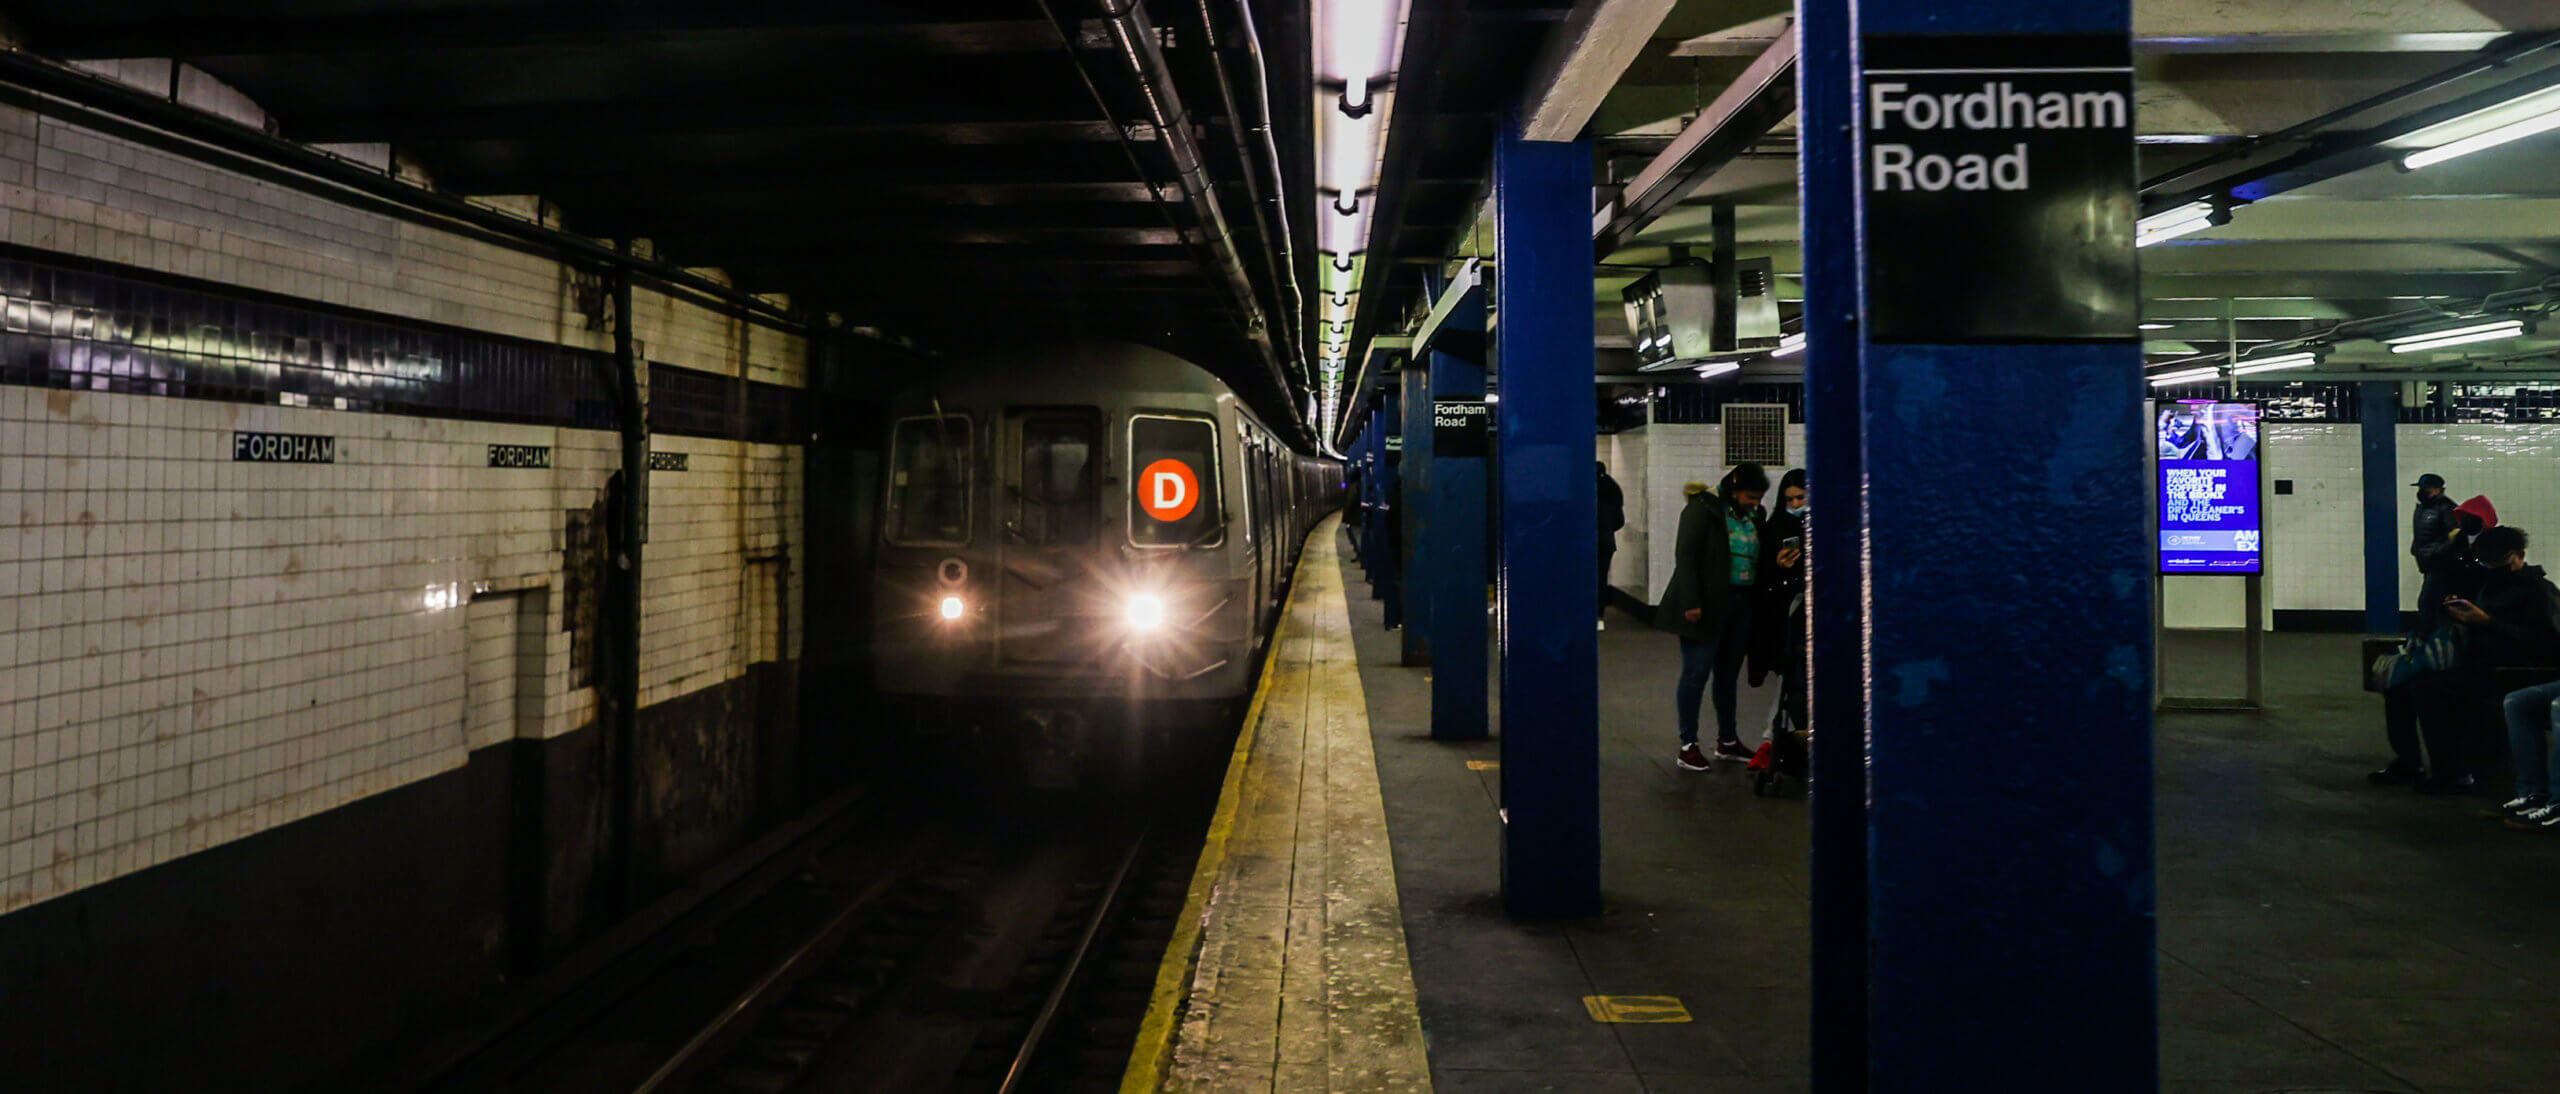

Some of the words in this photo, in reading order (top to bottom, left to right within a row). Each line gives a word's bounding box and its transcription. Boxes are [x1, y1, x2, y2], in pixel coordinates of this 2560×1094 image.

[1870, 82, 2127, 130] Fordham
[1872, 143, 2029, 191] Road
[1435, 404, 1486, 415] Fordham
[1435, 417, 1466, 427] Road
[235, 433, 333, 461] FORDHAM
[488, 446, 552, 466] FORDHAM
[2167, 469, 2197, 477] WHEN
[2199, 469, 2226, 477] YOUR
[2167, 477, 2213, 485] FAVORITE
[1154, 472, 1186, 509] D
[2215, 484, 2226, 492] IN
[2168, 506, 2188, 514] DRY
[2190, 506, 2244, 514] CLEANER'S
[2168, 513, 2178, 521] IN
[2181, 513, 2221, 522] QUEENS
[2234, 530, 2259, 541] AM
[2236, 541, 2259, 551] EX
